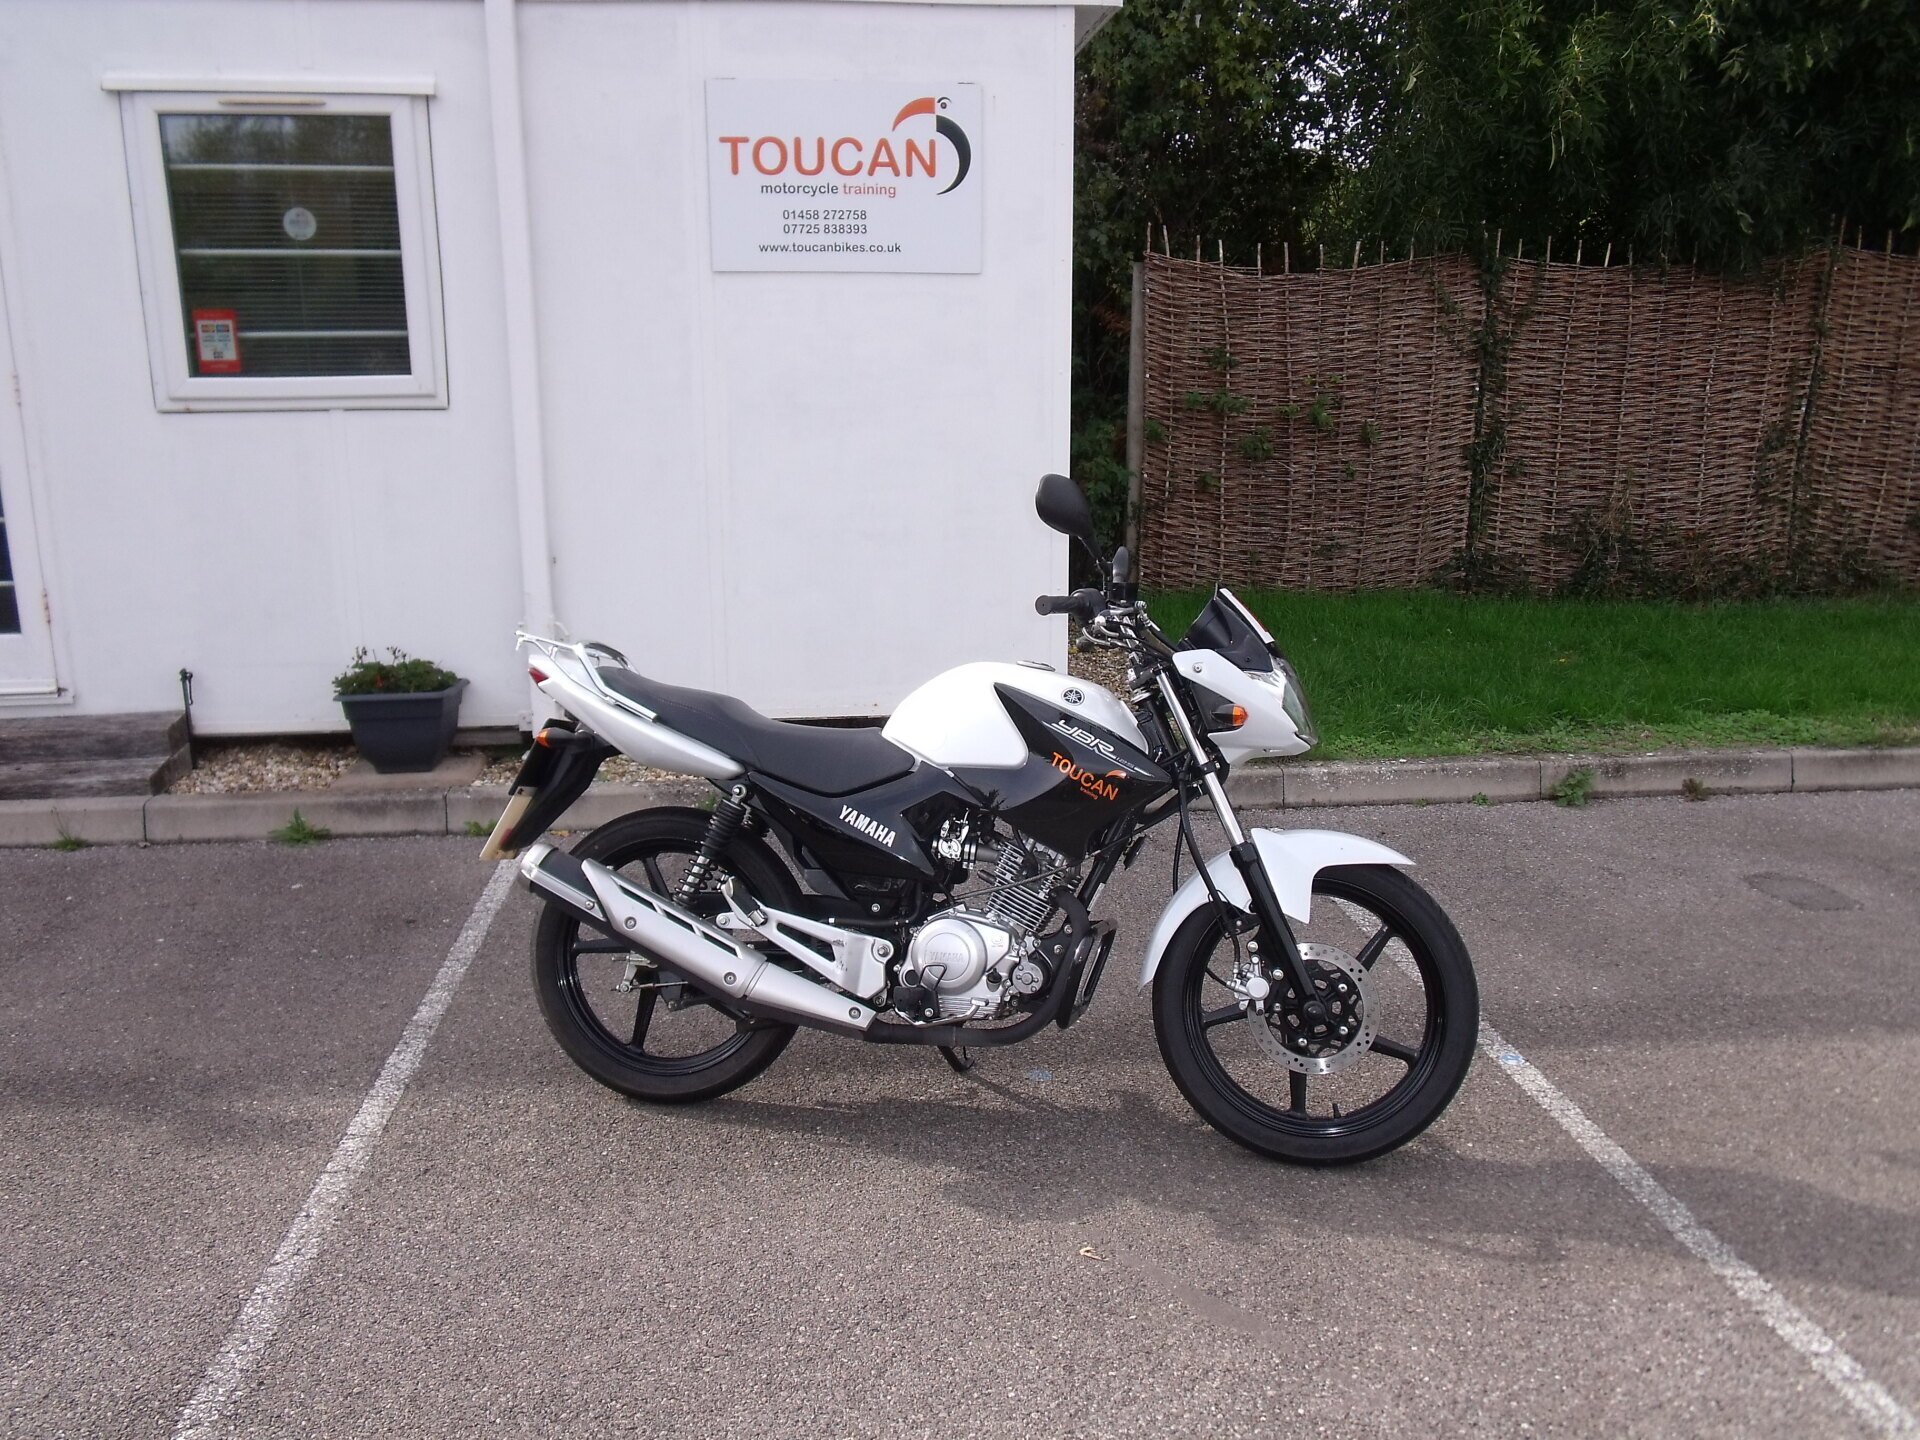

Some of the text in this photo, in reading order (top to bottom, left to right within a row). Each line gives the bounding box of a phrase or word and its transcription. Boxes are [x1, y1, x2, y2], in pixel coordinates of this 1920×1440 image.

[719, 136, 937, 178] TOUCAN
[760, 182, 897, 199] motorcycle training
[782, 209, 868, 221] 01458 272758
[783, 223, 868, 235] 07725 838393
[758, 242, 902, 253] www.toucanbikes.co.uk
[1051, 719, 1117, 760] YBR
[1051, 751, 1119, 801] TOUCAN
[839, 804, 897, 848] YAMAHA
